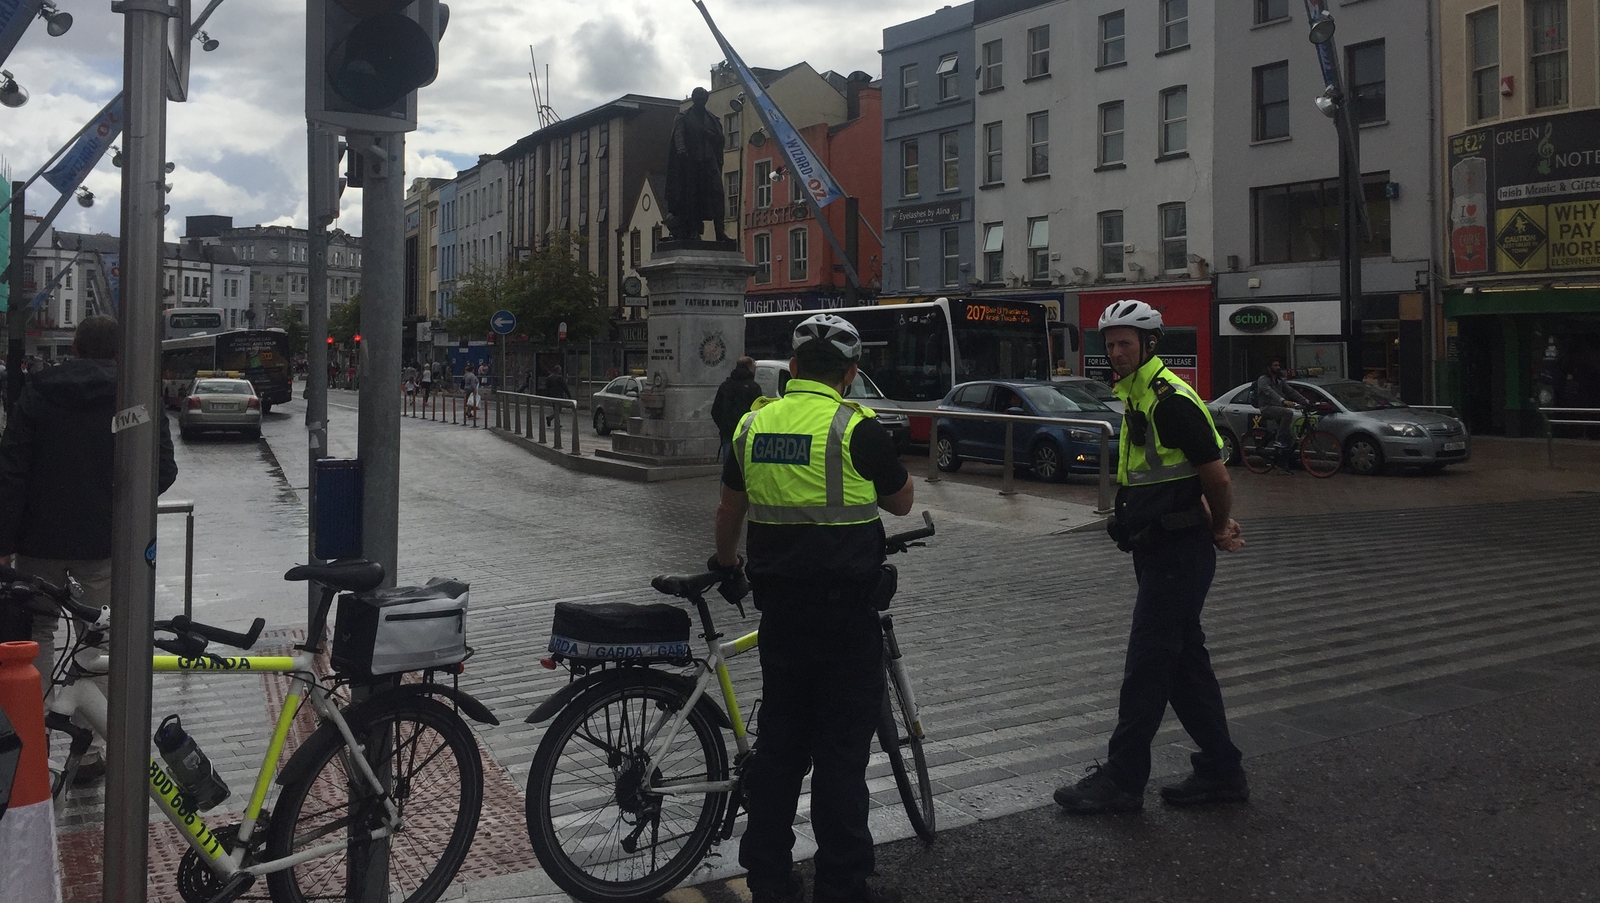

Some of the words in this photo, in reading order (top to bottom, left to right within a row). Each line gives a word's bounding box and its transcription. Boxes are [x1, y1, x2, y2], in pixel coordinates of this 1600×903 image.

[1496, 126, 1540, 145] GREEN
[786, 138, 814, 176] WIZARD
[808, 178, 829, 202] OZ
[1499, 187, 1522, 199] Irish
[1525, 183, 1556, 195] Music
[1559, 182, 1566, 192] &
[1571, 179, 1600, 192] Gifts
[899, 210, 926, 221] Eyelashes
[927, 208, 934, 218] by
[935, 207, 950, 216] Alina
[1554, 203, 1600, 222] WHY
[1504, 234, 1536, 243] CAUTION
[1559, 222, 1595, 240] PAY
[1552, 240, 1600, 258] MORE
[1551, 256, 1600, 267] ELSEWHERE
[685, 298, 710, 306] FATHER
[711, 299, 739, 307] MATHEW
[744, 299, 775, 313] ILIGHT
[966, 304, 986, 321] 207
[1235, 313, 1267, 324] schuh
[622, 328, 648, 341] MICHE
[1174, 358, 1192, 366] LEASE
[754, 436, 809, 462] GARDA
[595, 646, 643, 658] GARDA
[196, 822, 220, 855] 111
